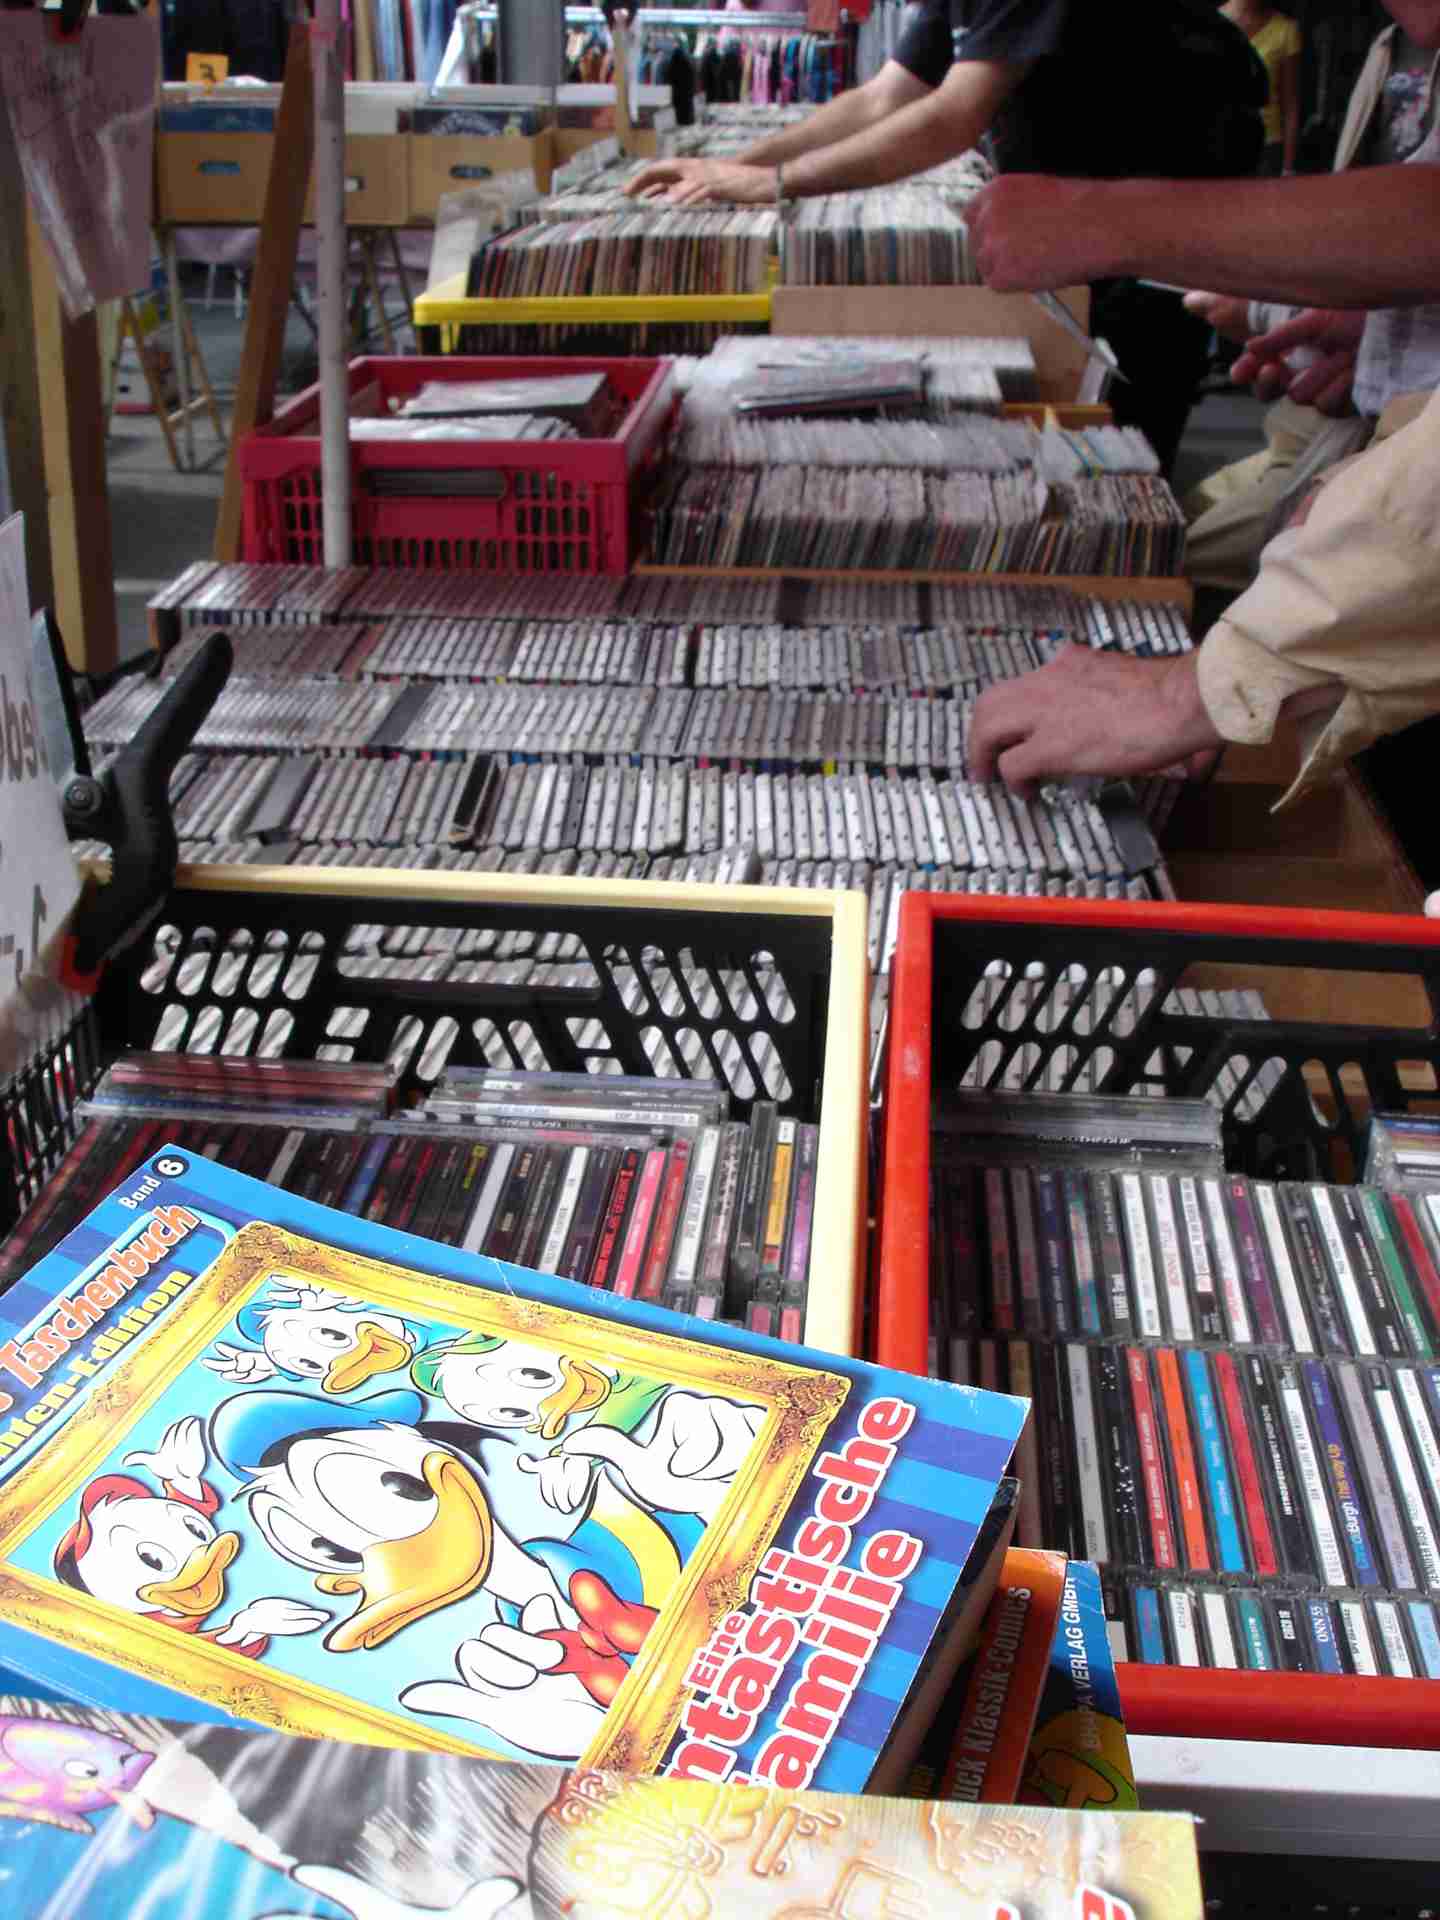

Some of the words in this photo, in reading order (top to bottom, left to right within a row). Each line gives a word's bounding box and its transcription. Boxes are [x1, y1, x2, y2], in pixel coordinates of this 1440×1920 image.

[118, 1176, 161, 1210] Band
[157, 1159, 184, 1177] 6
[0, 1204, 201, 1389] Taschenbuch
[1342, 1501, 1361, 1536] Burgh
[689, 1614, 746, 1690] Eine
[732, 1532, 920, 1790] amilie
[1065, 1626, 1091, 1688] VERLAG
